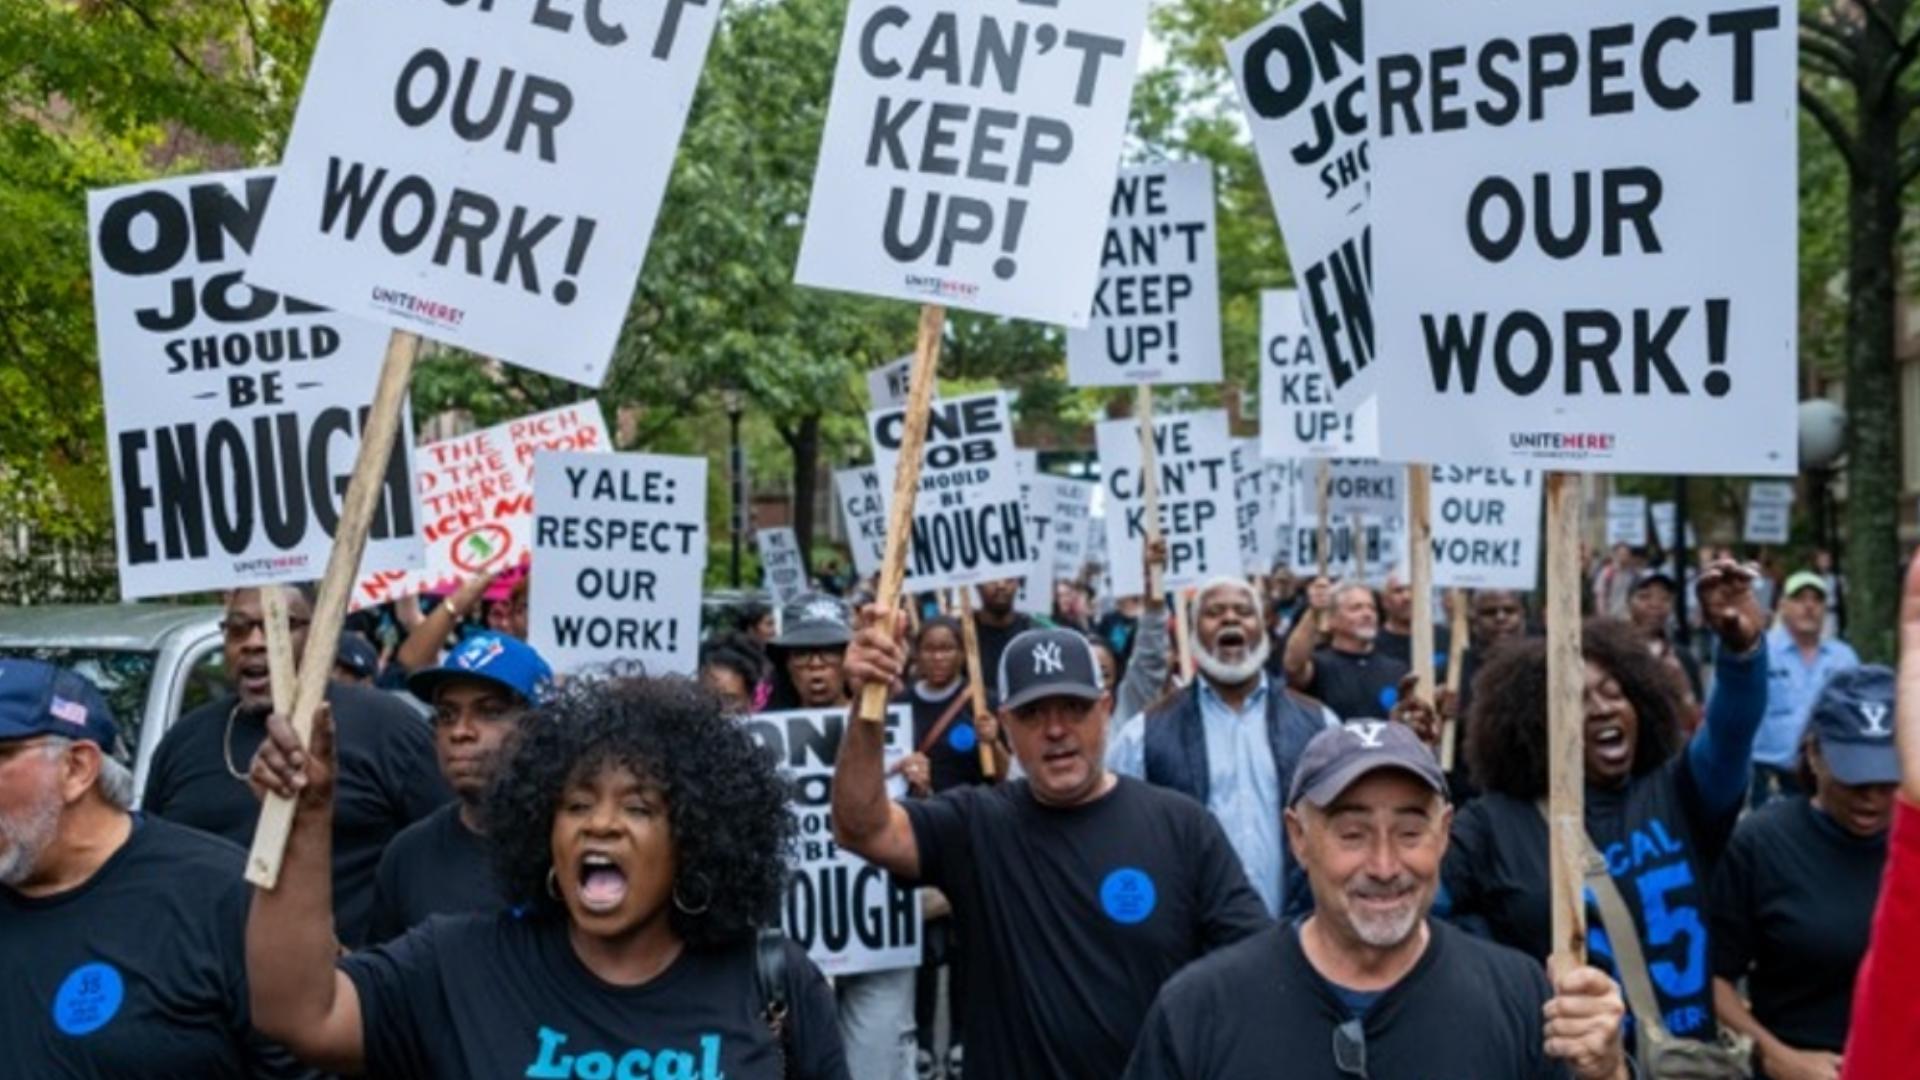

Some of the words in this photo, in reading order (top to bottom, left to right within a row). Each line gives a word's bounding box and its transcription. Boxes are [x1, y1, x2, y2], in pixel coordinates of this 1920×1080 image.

[1377, 5, 1780, 138] RESPECT
[394, 47, 575, 164] OUR
[865, 96, 1074, 188] KEEP
[320, 156, 597, 306] WORK!
[882, 187, 1028, 280] UP!
[1466, 166, 1663, 263] OUR
[134, 269, 335, 332] JO
[1091, 273, 1192, 318] KEEP
[164, 324, 340, 373] SHOULD
[1106, 320, 1179, 365] UP!
[1420, 299, 1731, 397] WORK!
[509, 410, 580, 443] RICH
[1136, 422, 1191, 455] WE
[1295, 412, 1354, 442] UP!
[1509, 432, 1616, 448] UNITEHERE!
[925, 439, 997, 469] OB
[119, 406, 415, 566] ENOUGH
[565, 467, 677, 505] YALE:
[917, 468, 991, 492] HOULD
[1441, 497, 1505, 525] OUR
[536, 515, 699, 555] RESPECT
[903, 501, 1027, 577] NOUGH
[1163, 537, 1207, 575] P!
[576, 568, 657, 601] OUR
[553, 615, 678, 653] WORK!
[1032, 642, 1065, 674] NY
[1345, 722, 1387, 748] Y
[1860, 702, 1891, 737] Y
[526, 1026, 725, 1080] Local
